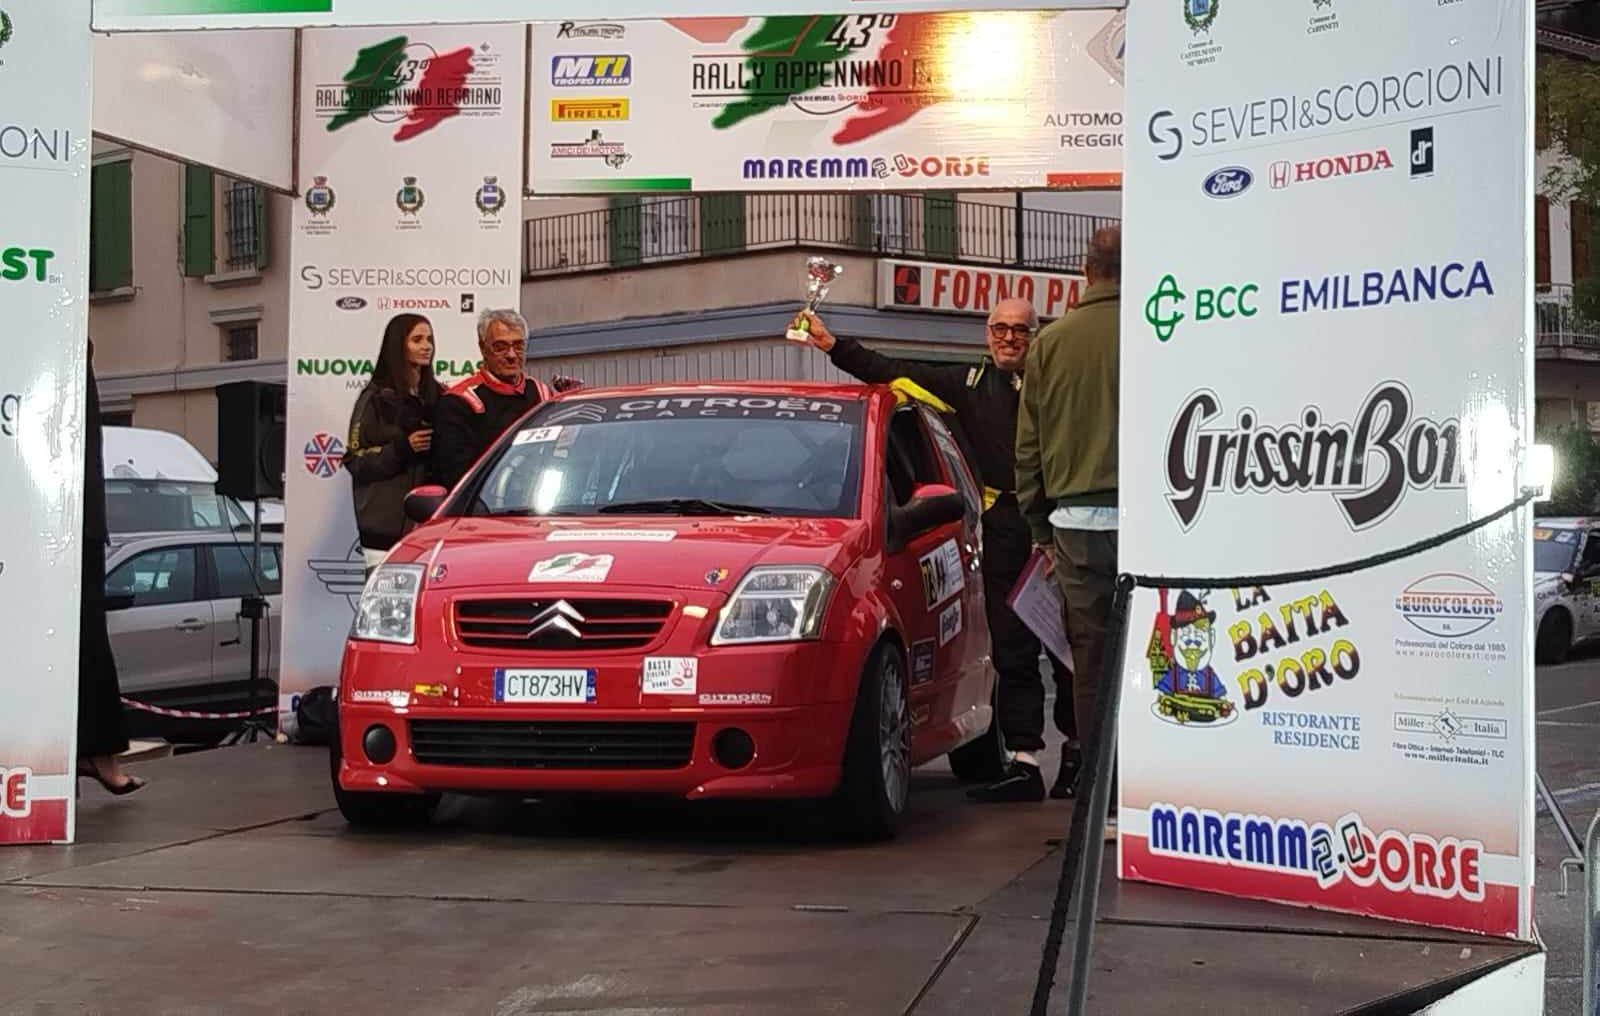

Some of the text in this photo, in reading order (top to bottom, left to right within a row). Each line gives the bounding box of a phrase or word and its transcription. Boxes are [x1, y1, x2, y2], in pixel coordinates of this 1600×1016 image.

[554, 57, 629, 78] MTI
[692, 61, 766, 90] RALLY
[775, 59, 902, 88] APPENNINO
[596, 77, 630, 85] ITALIA
[316, 87, 356, 107] RALLY
[437, 87, 501, 105] REGGIANO
[1191, 56, 1503, 146] SEVERI&SCORCIONI
[558, 103, 621, 118] PIRELLI
[1207, 170, 1247, 195] Ford
[1294, 150, 1394, 182] HONDA
[0, 247, 55, 282] ST
[328, 269, 511, 286] SEVERI&SCORCIONI
[932, 268, 1035, 310] FORNO
[1195, 260, 1495, 321] BCC EMILBANCA
[392, 299, 451, 309] HONDA
[297, 359, 375, 376] NUOVA
[1231, 585, 1271, 612] LA
[1227, 588, 1350, 663] BAITA
[508, 675, 584, 697] CT873HV
[1237, 639, 1361, 711] D'ORO
[1263, 711, 1361, 731] RISTORANTE
[1398, 717, 1500, 734] Miller Italia
[1274, 730, 1361, 750] RESIDENCE
[0, 772, 27, 811] E
[1347, 831, 1481, 895] CORSE
